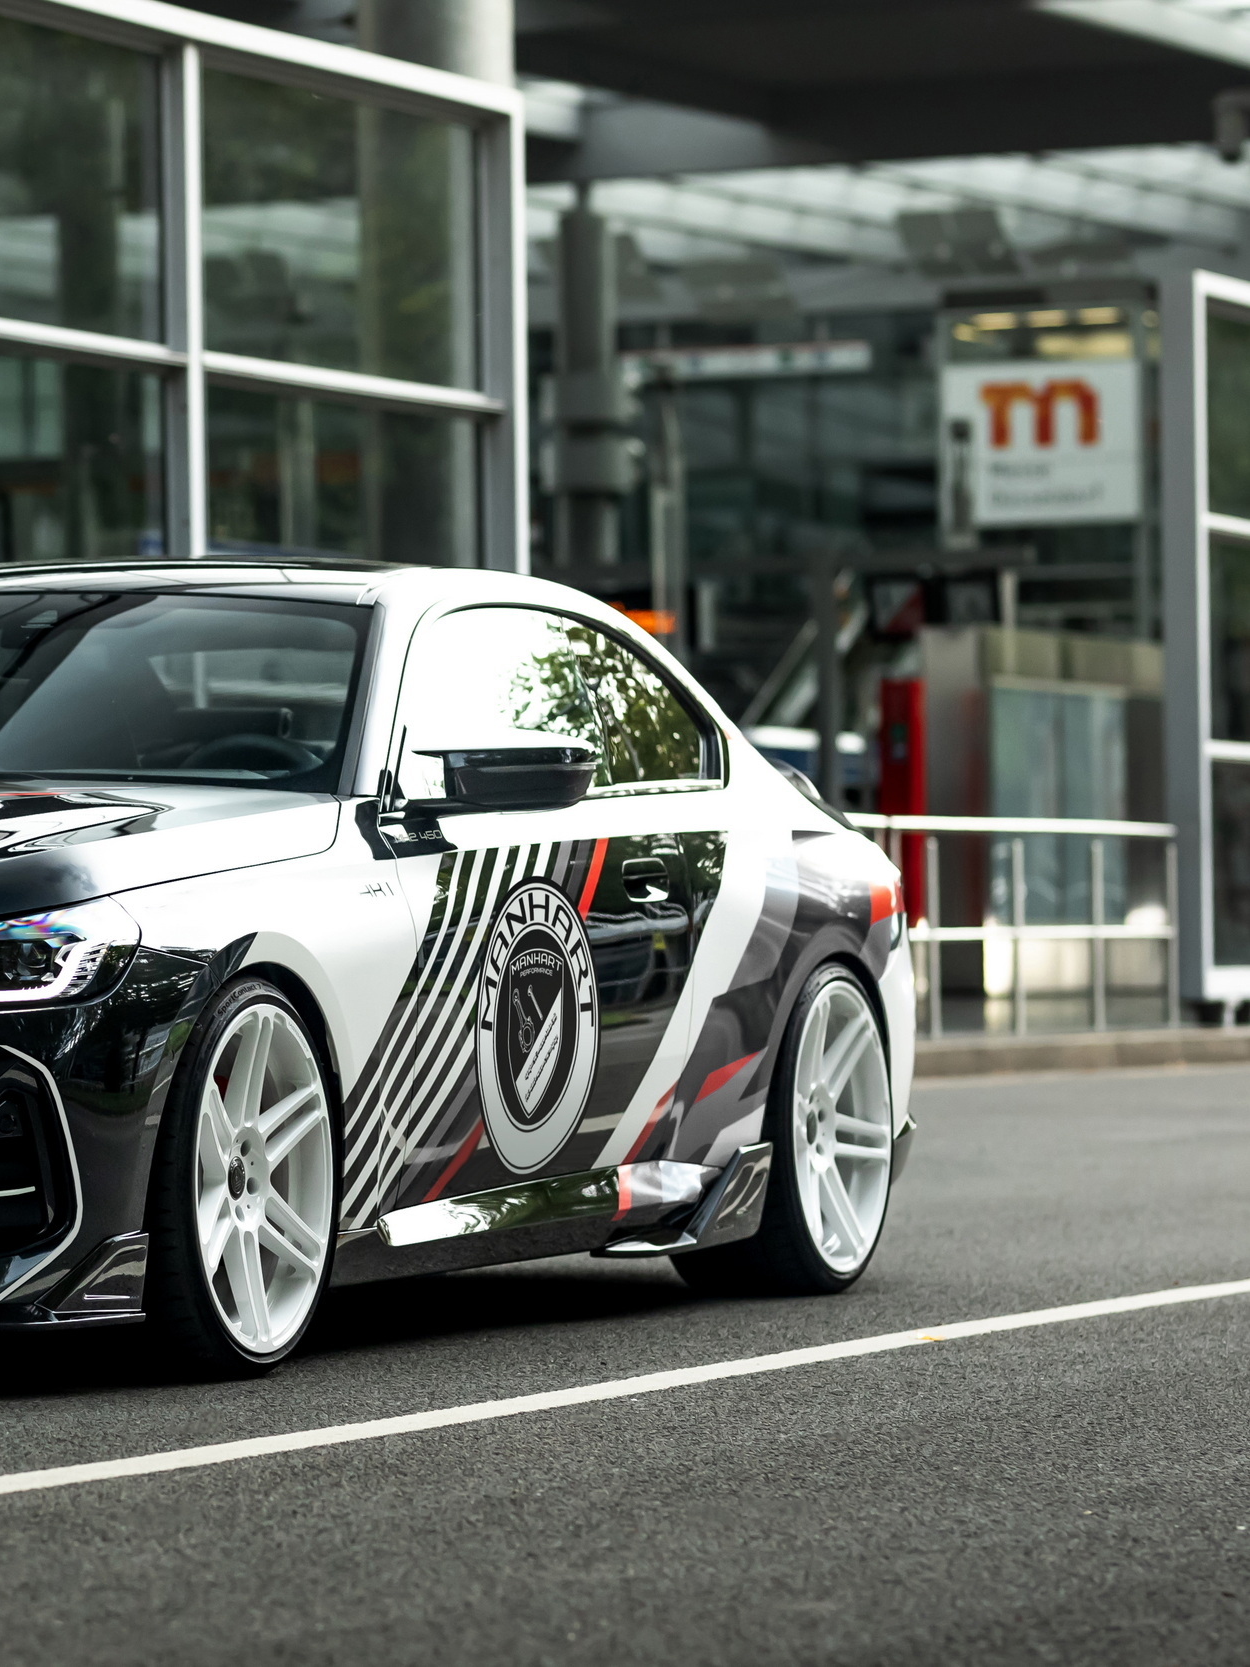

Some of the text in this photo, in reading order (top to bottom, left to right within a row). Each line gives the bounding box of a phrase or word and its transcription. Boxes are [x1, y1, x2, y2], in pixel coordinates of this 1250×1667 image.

[419, 829, 442, 840] 450
[481, 892, 595, 1031] MANHART
[511, 952, 562, 976] MANHART
[217, 984, 258, 1018] SportContact
